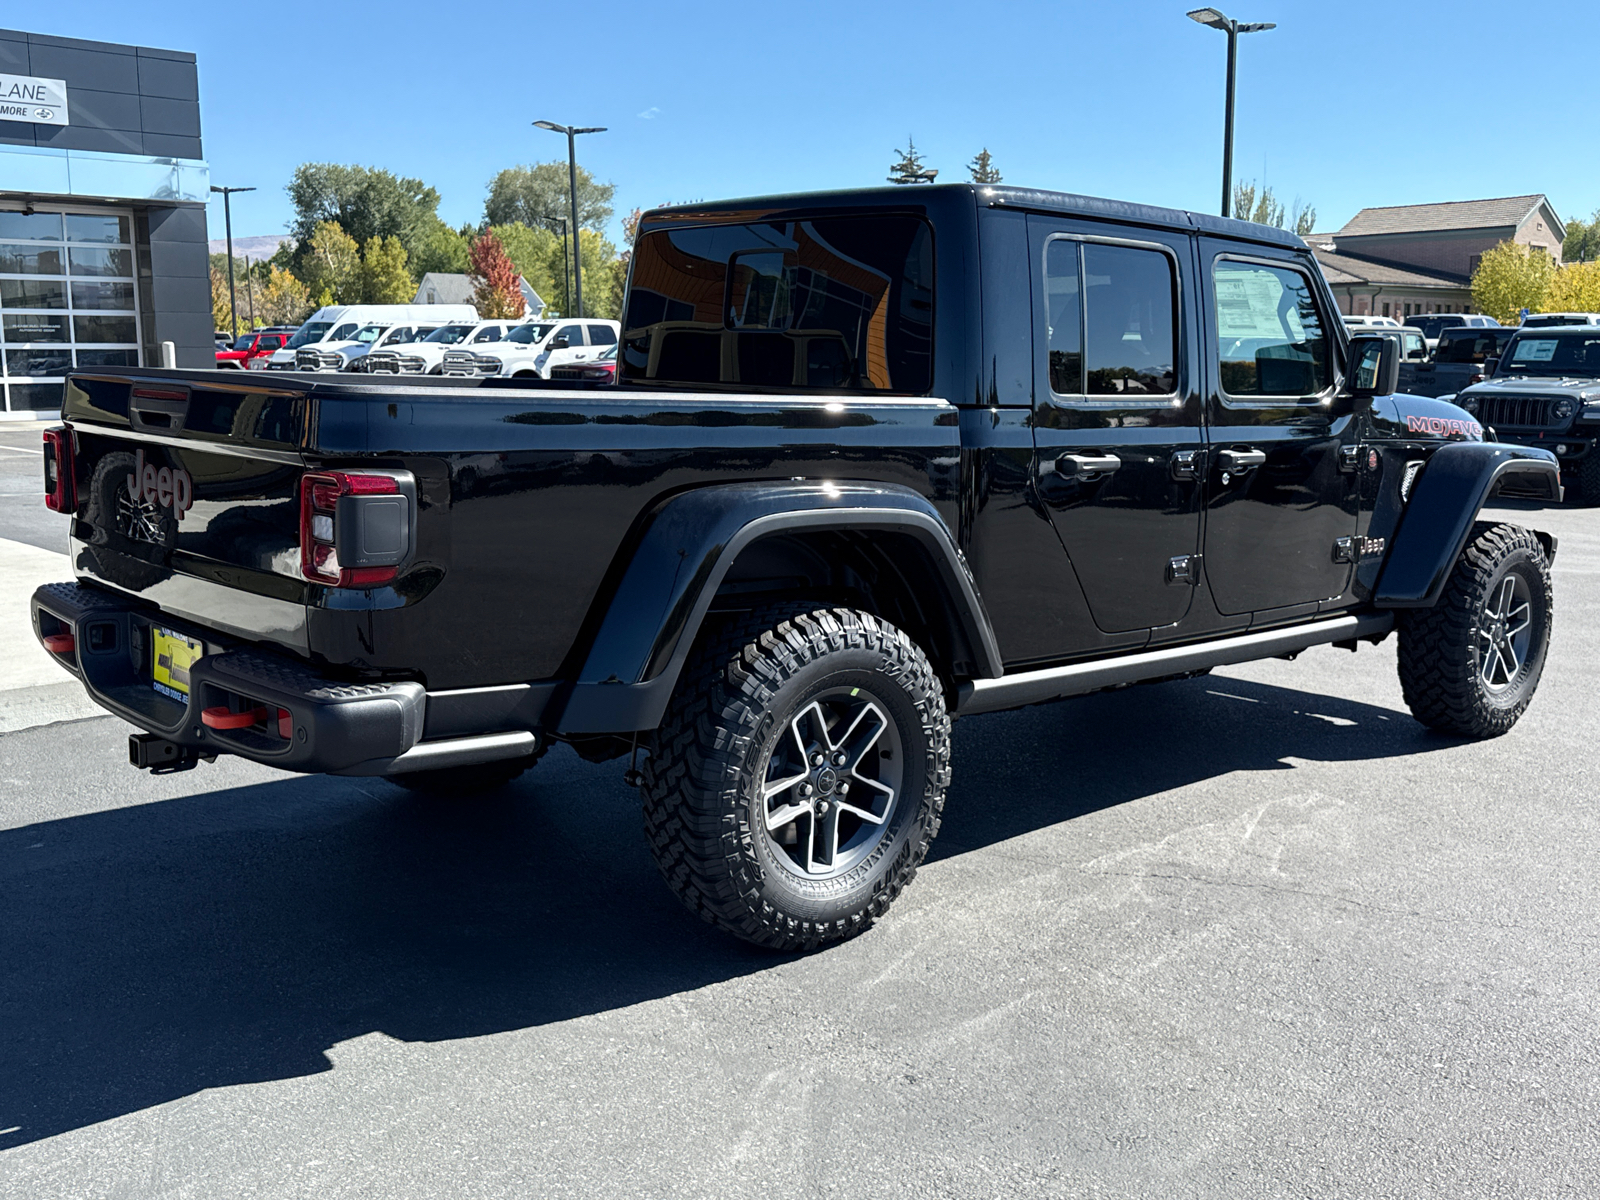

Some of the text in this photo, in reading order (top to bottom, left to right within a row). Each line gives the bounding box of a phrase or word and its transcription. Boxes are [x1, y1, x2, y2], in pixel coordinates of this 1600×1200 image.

[0, 105, 28, 117] MORE
[1406, 415, 1483, 437] MOJAVE
[127, 448, 193, 520] Jeep
[1360, 536, 1385, 556] Jeep
